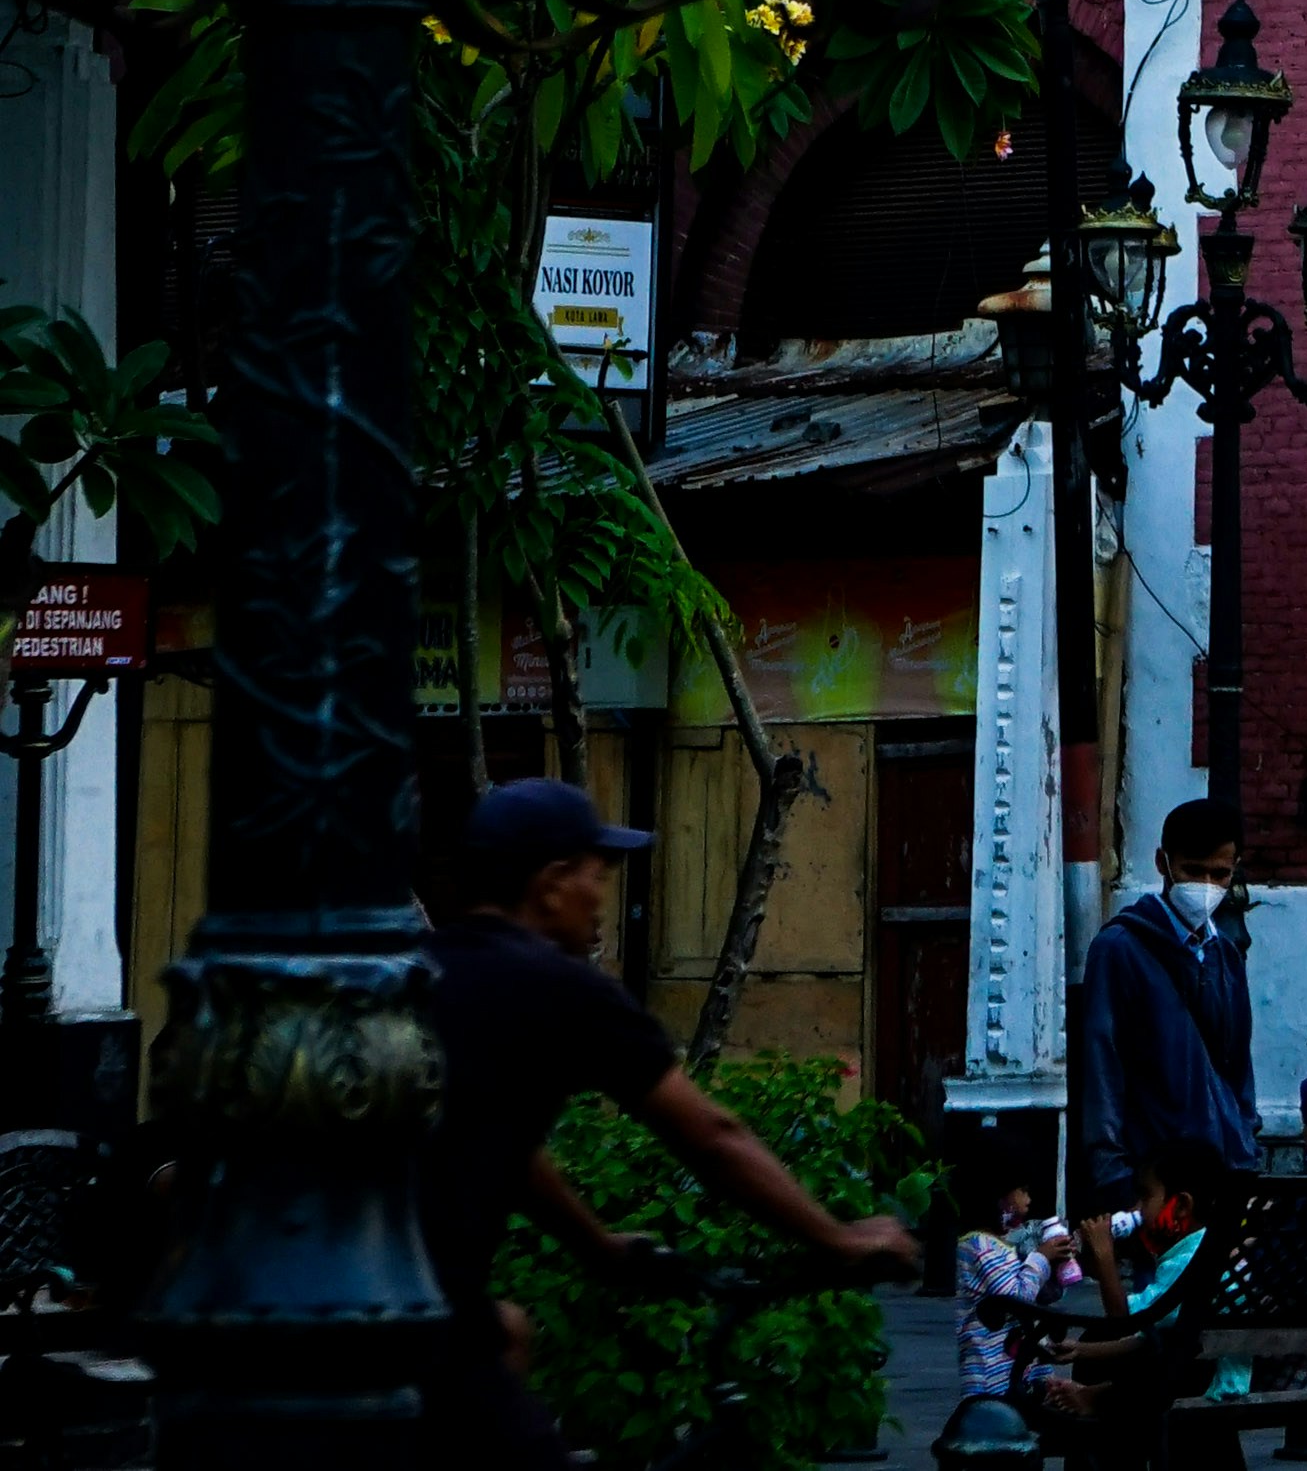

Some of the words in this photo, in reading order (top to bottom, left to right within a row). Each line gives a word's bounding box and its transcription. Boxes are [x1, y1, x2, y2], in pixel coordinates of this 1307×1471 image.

[541, 267, 578, 294] NASI
[581, 269, 635, 297] KOYOR
[26, 610, 40, 630] DI
[43, 609, 123, 630] SEPANJANG
[12, 636, 104, 658] PEDESTRIAN
